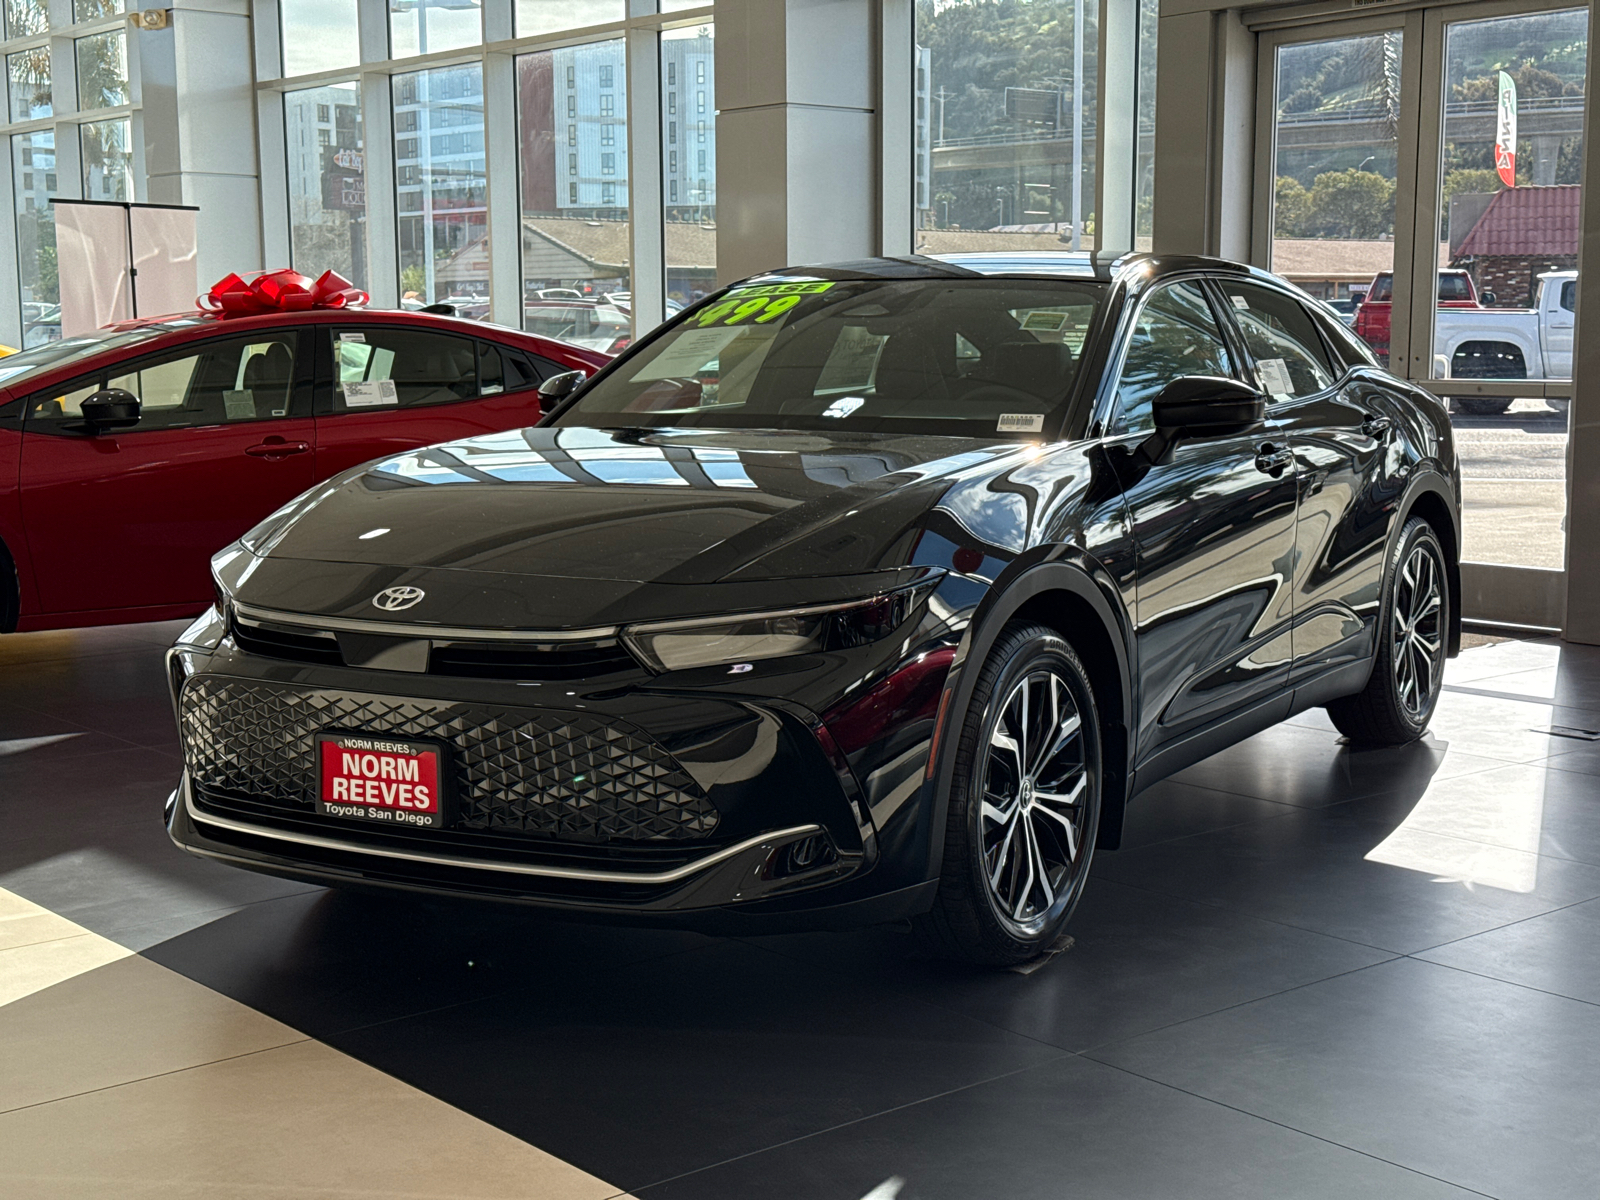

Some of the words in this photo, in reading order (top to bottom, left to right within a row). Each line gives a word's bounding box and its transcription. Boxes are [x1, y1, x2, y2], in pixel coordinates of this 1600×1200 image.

[344, 738, 372, 750] NORM
[374, 741, 410, 754] REEVES
[342, 752, 419, 783] NORM
[333, 777, 430, 809] REEVES
[324, 802, 365, 817] Toyota
[368, 807, 392, 820] San
[395, 810, 433, 826] Diego
